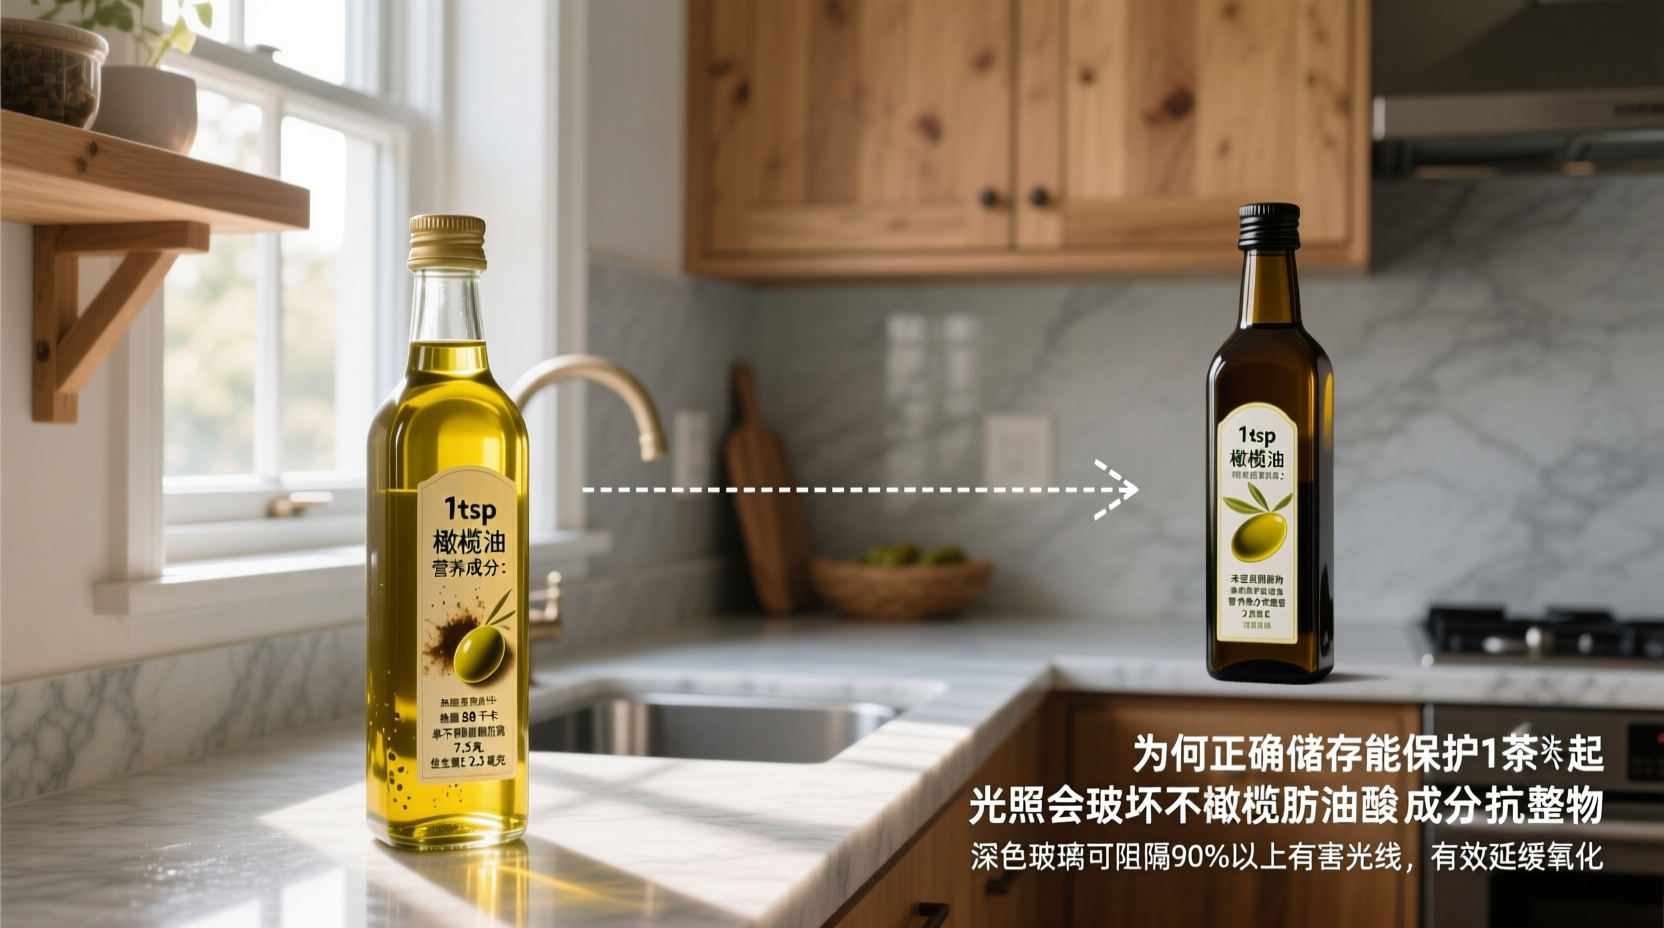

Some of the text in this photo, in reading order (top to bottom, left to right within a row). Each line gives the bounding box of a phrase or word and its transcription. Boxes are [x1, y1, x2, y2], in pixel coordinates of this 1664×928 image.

[1239, 425, 1276, 448] 1tsp
[444, 496, 497, 526] 1tsp
[432, 528, 505, 555] 橄榄油
